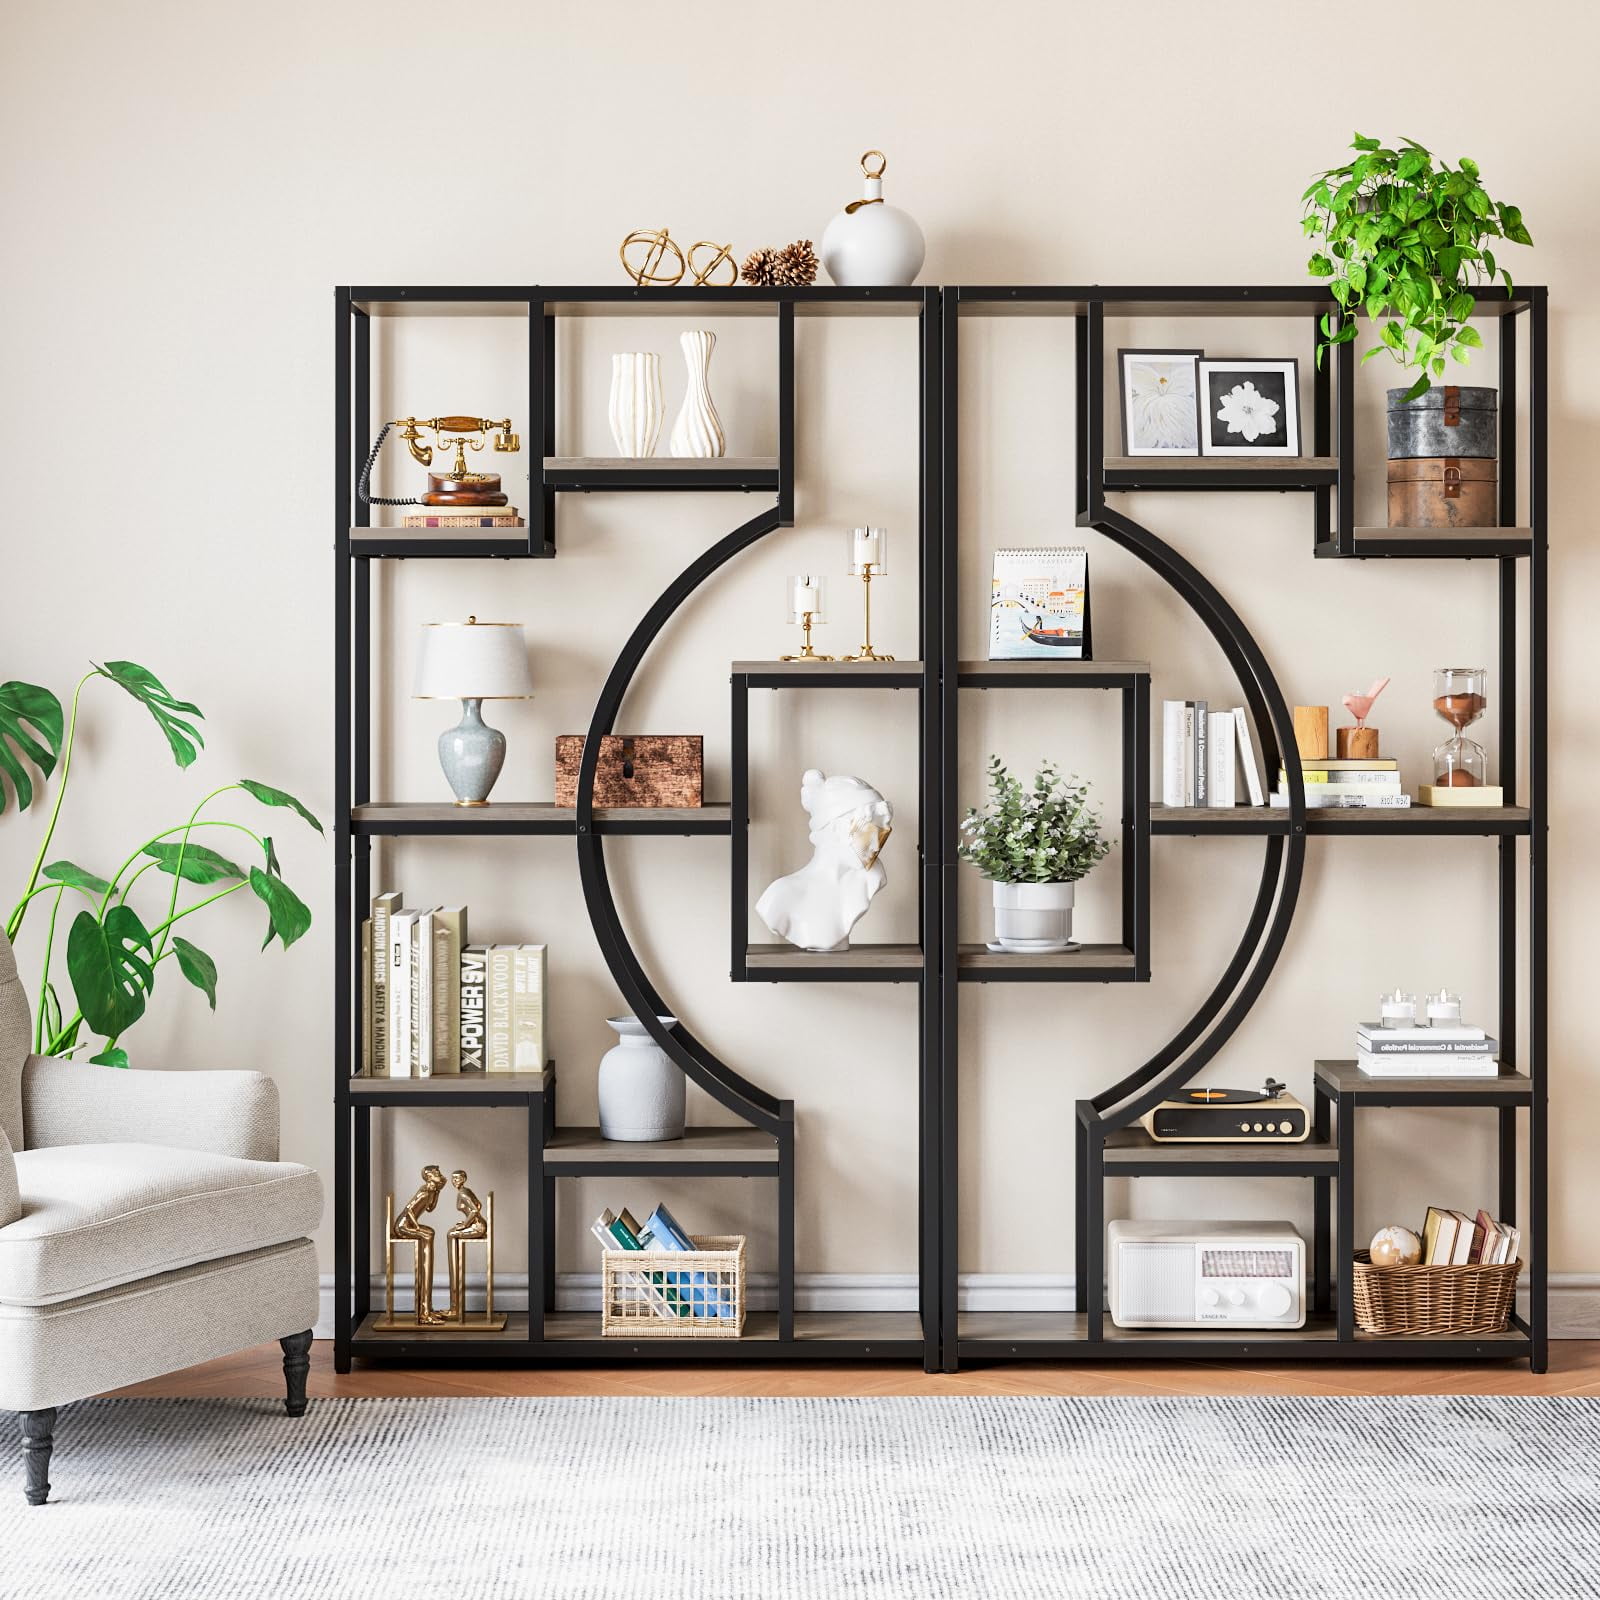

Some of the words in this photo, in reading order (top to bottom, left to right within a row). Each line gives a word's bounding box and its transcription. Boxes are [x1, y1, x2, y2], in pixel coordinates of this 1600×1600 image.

[374, 952, 386, 983] BASICS
[374, 984, 386, 1015] SAFETY
[493, 954, 510, 1028] BLACKWOOD
[374, 1026, 386, 1070] HANDLING
[493, 1032, 510, 1068] DAVID
